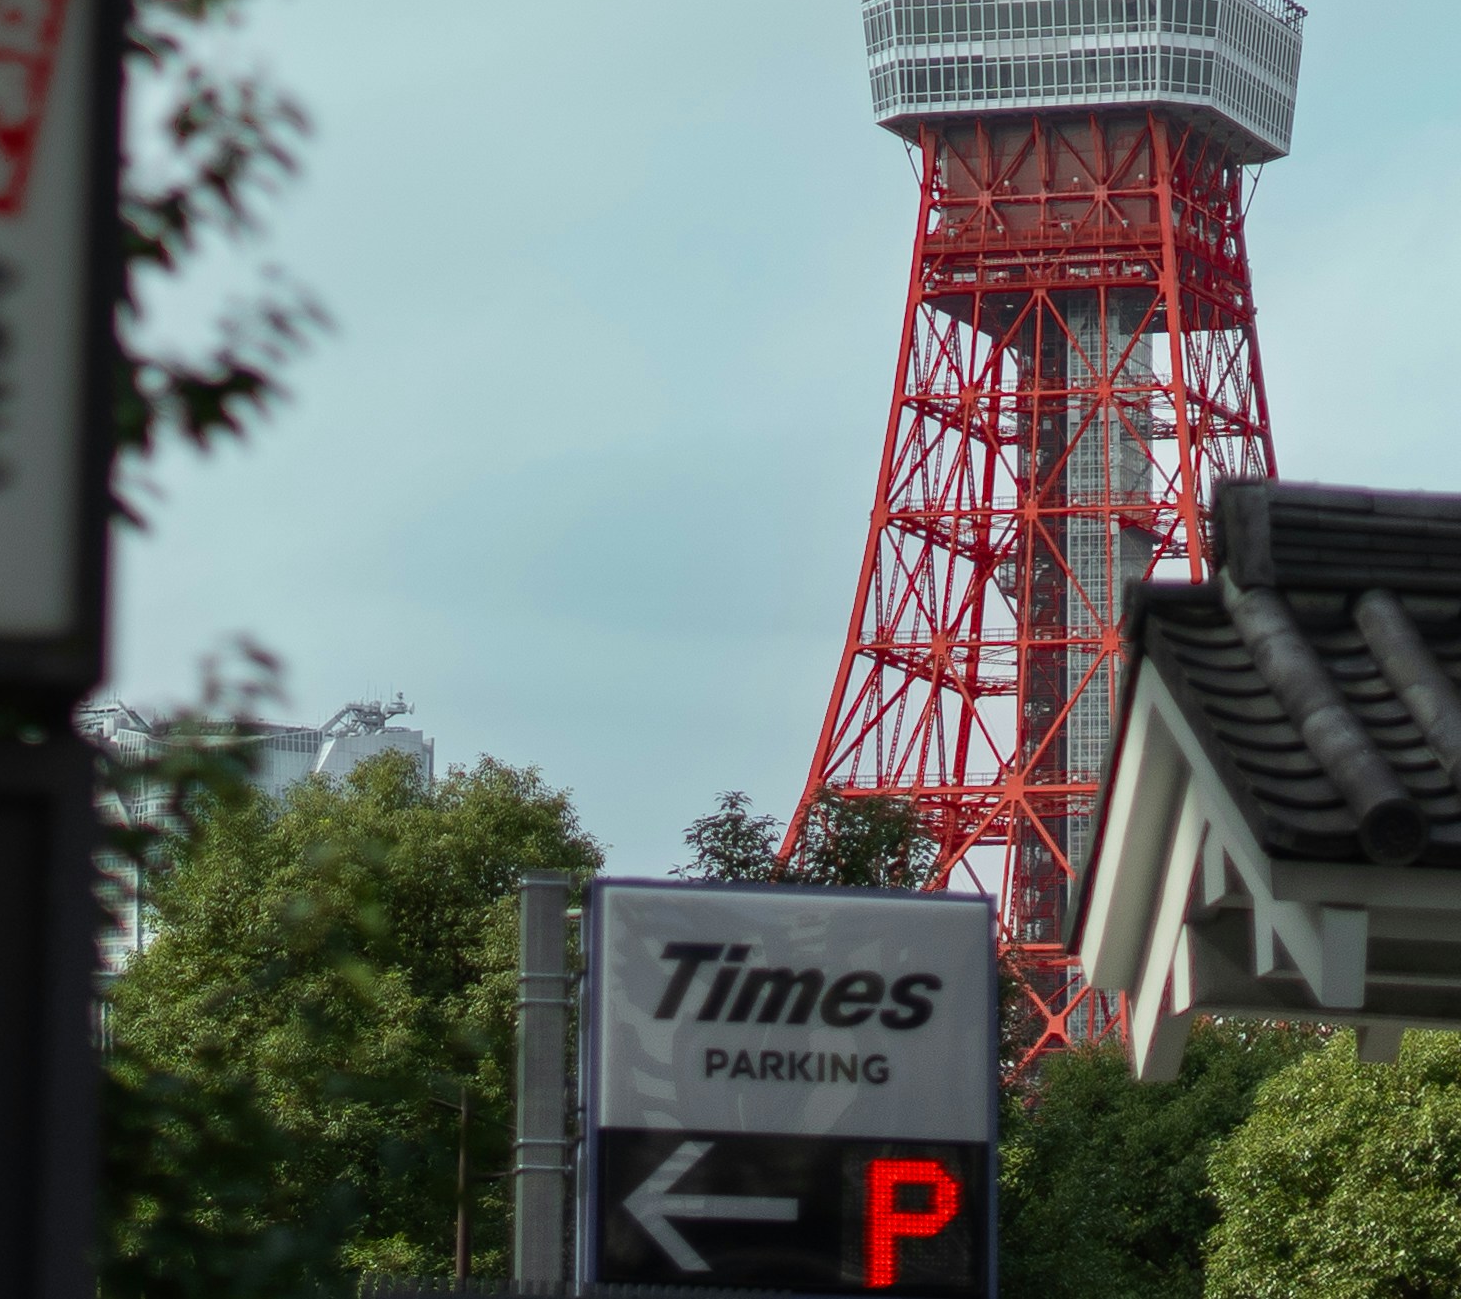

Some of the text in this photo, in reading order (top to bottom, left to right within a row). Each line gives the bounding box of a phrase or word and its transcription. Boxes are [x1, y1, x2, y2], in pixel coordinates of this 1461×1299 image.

[653, 941, 943, 1030] Times
[705, 1048, 890, 1085] PARKING
[864, 1158, 963, 1289] P
